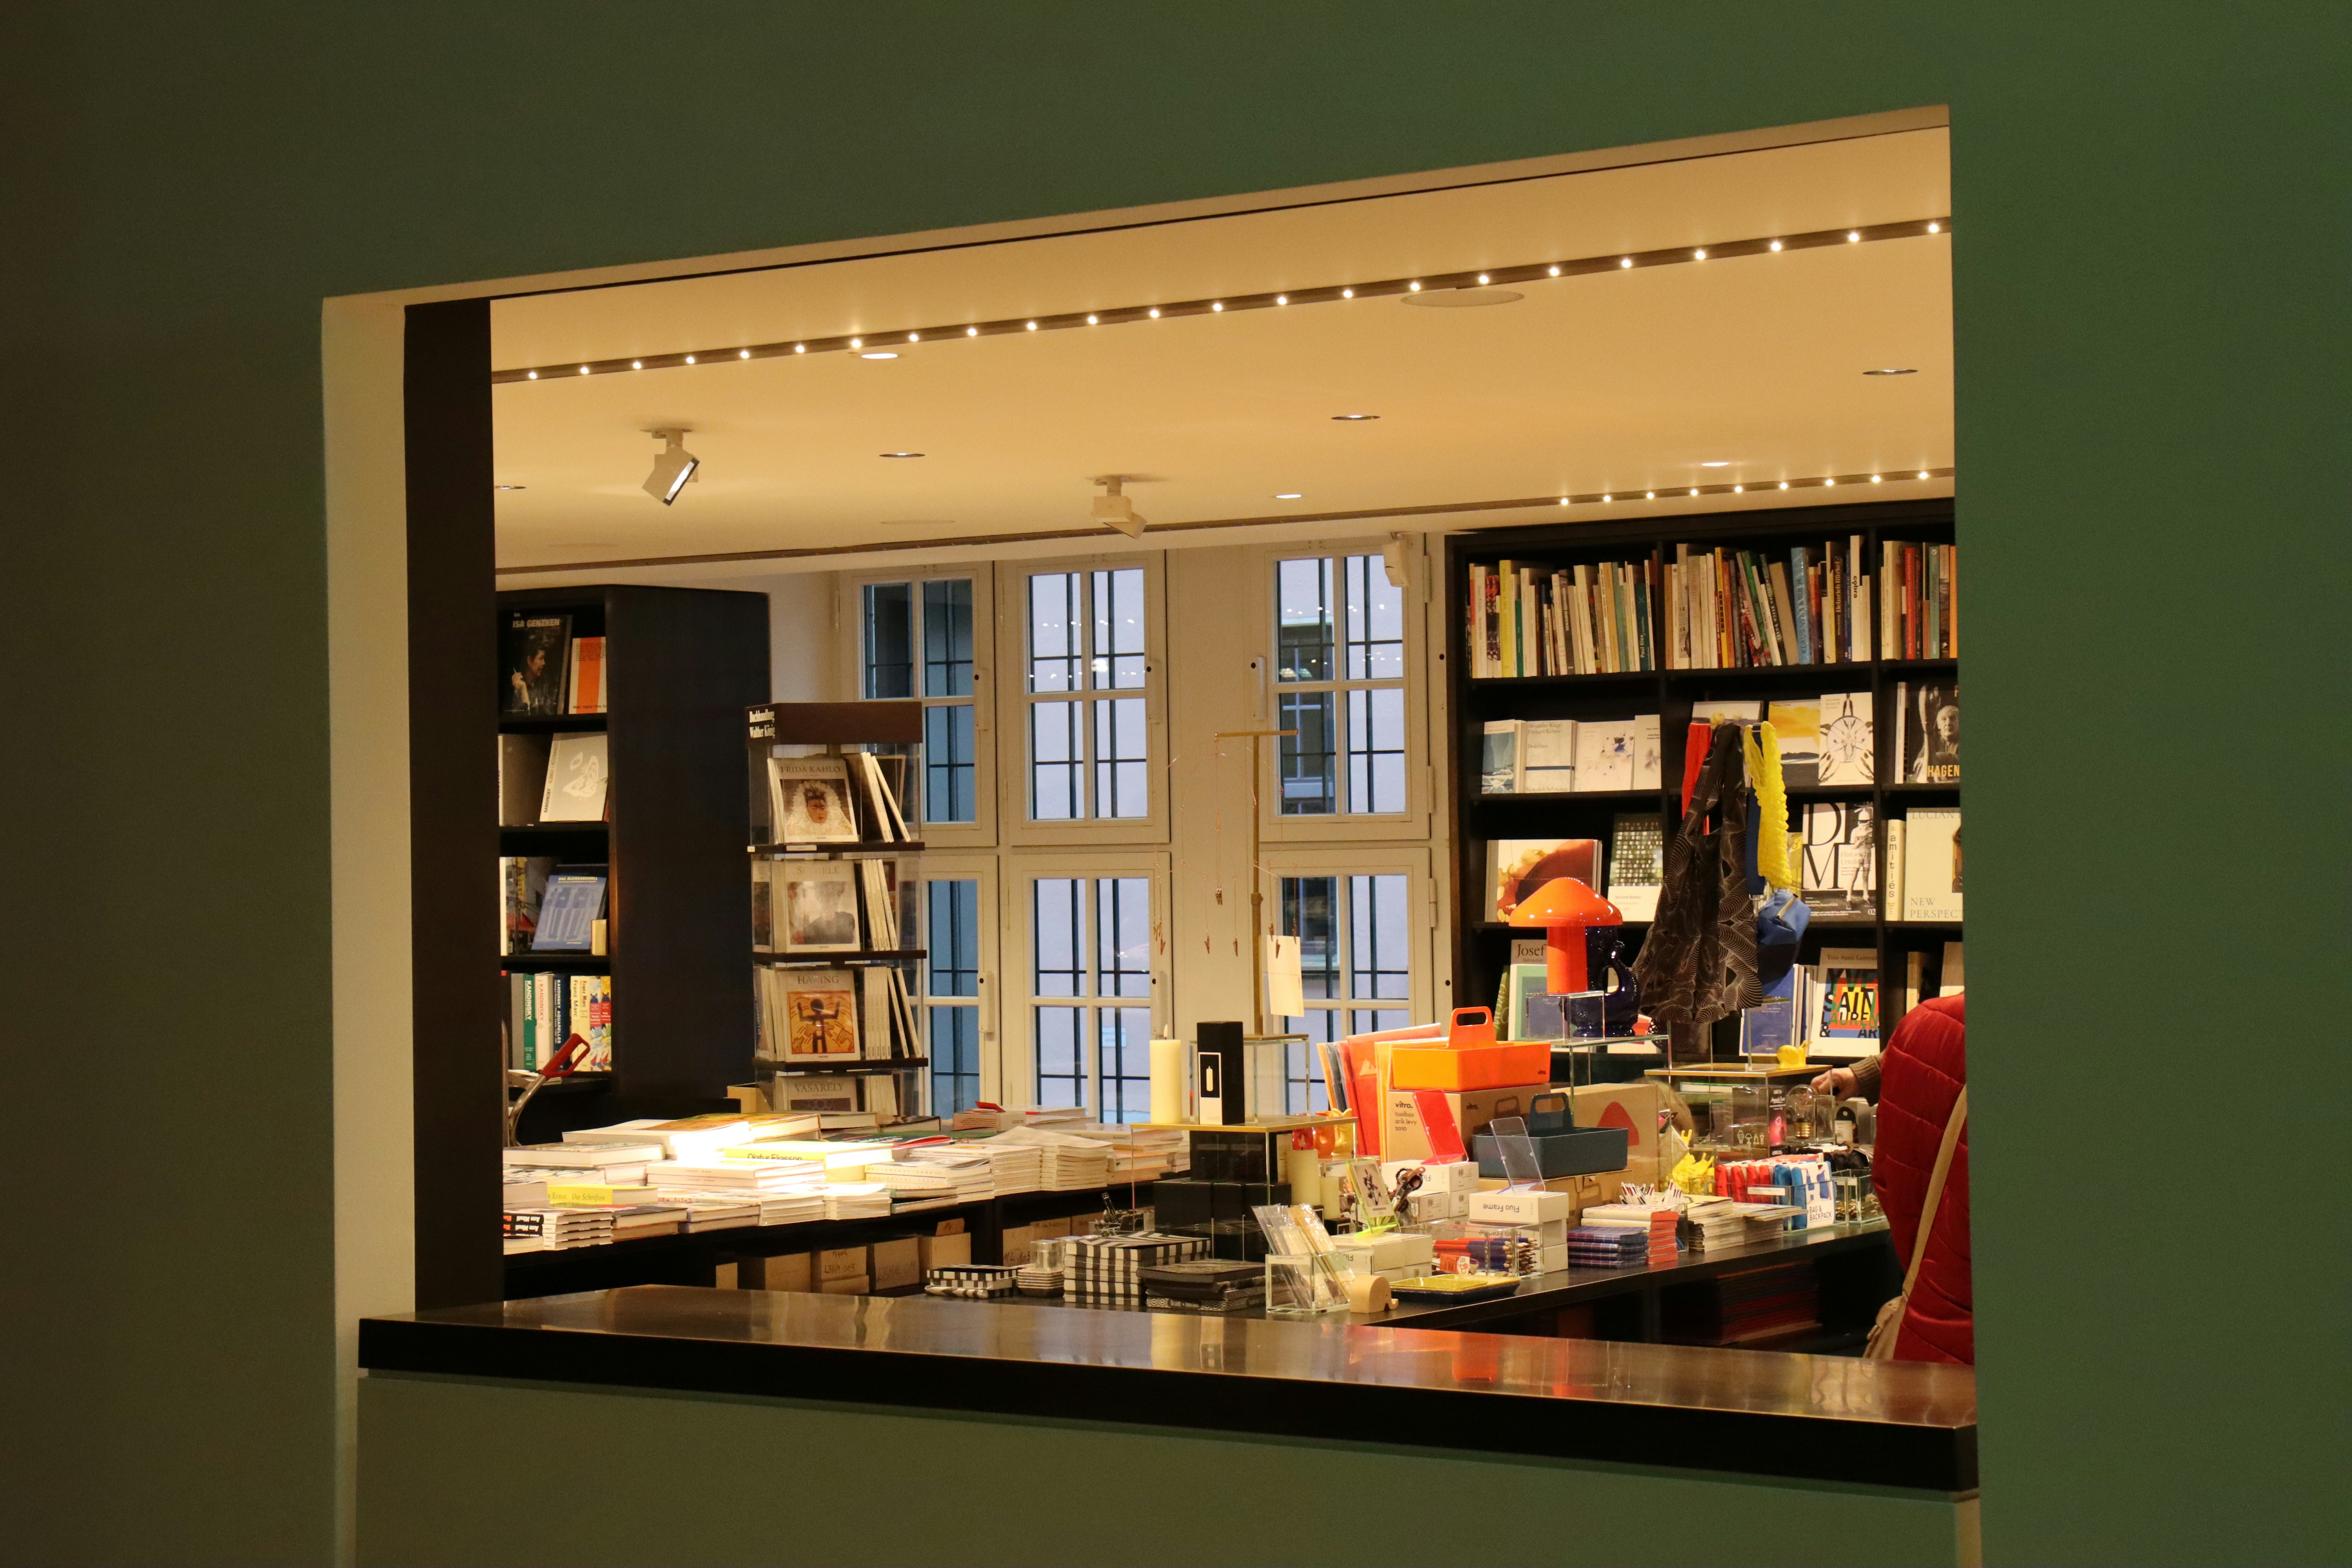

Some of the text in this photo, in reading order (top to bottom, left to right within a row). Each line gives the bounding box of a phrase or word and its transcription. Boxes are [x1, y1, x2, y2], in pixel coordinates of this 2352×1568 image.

[512, 618, 560, 628] ISA GENZKEN
[809, 765, 840, 773] KAHLO
[1927, 765, 1960, 777] HAGEN
[1912, 811, 1954, 819] LUCIAN
[1889, 835, 1897, 898] amitiés
[1910, 897, 1935, 906] NEW
[1517, 944, 1547, 958] Josef
[794, 1082, 844, 1092] VASARELY
[1395, 1100, 1413, 1109] vitra.
[581, 1193, 605, 1202] Schriften
[1483, 1204, 1504, 1212] Frame
[1809, 1211, 1832, 1221] BACKPACK
